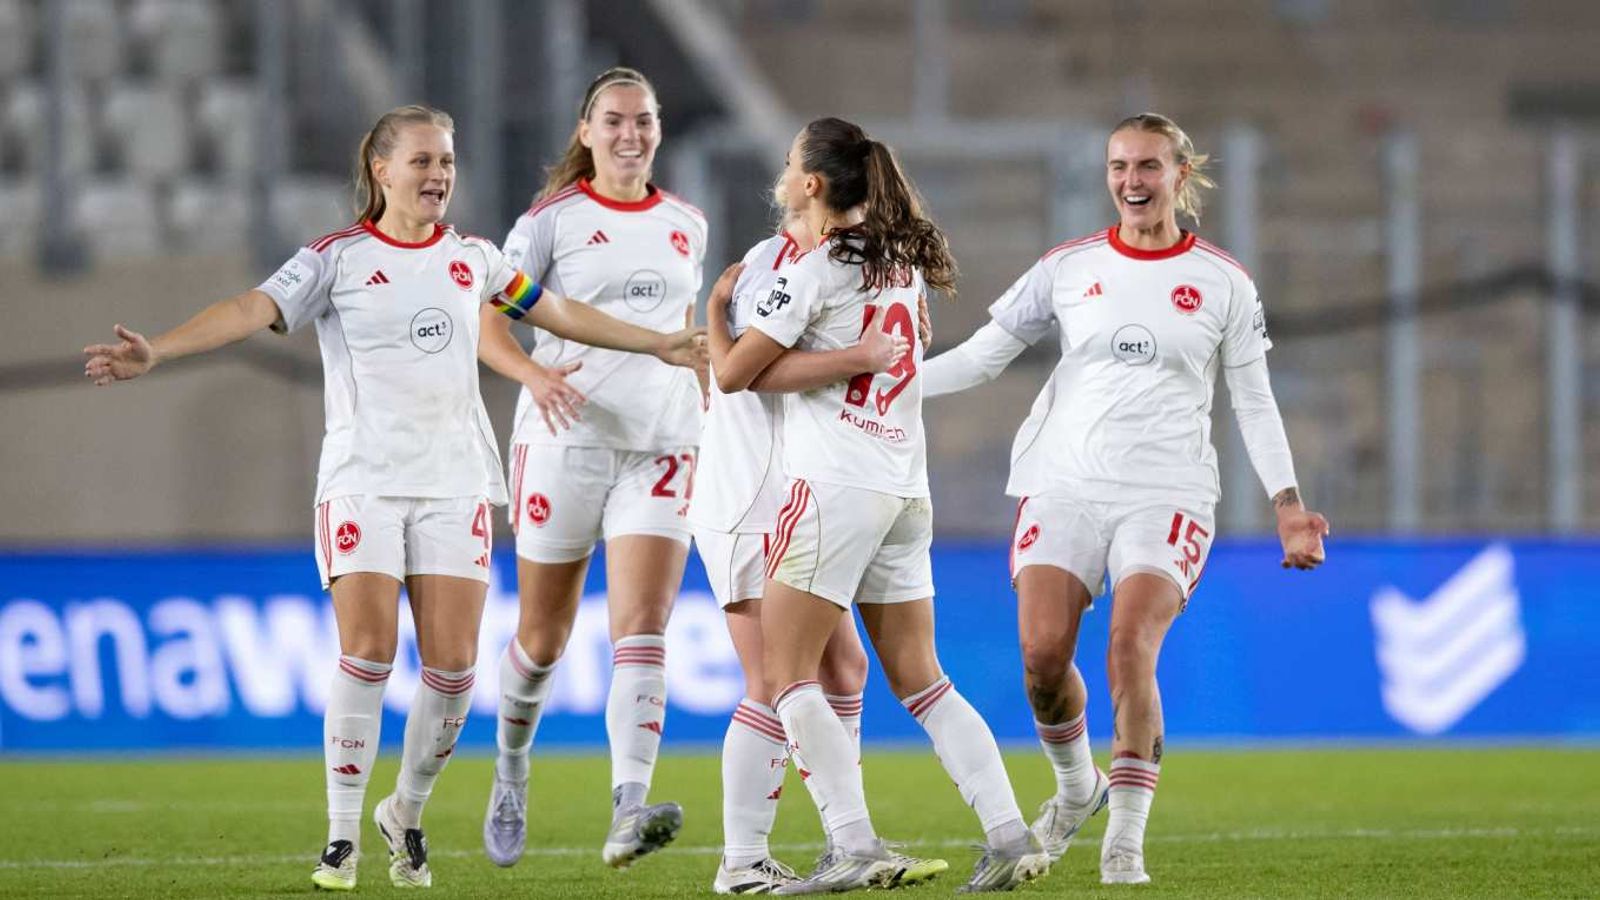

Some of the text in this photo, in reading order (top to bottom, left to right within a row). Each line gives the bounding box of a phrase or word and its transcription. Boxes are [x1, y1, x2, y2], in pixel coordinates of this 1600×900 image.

[1174, 293, 1200, 308] FCN
[471, 502, 490, 550] 4
[1167, 511, 1209, 565] 15
[332, 736, 365, 749] FCN
